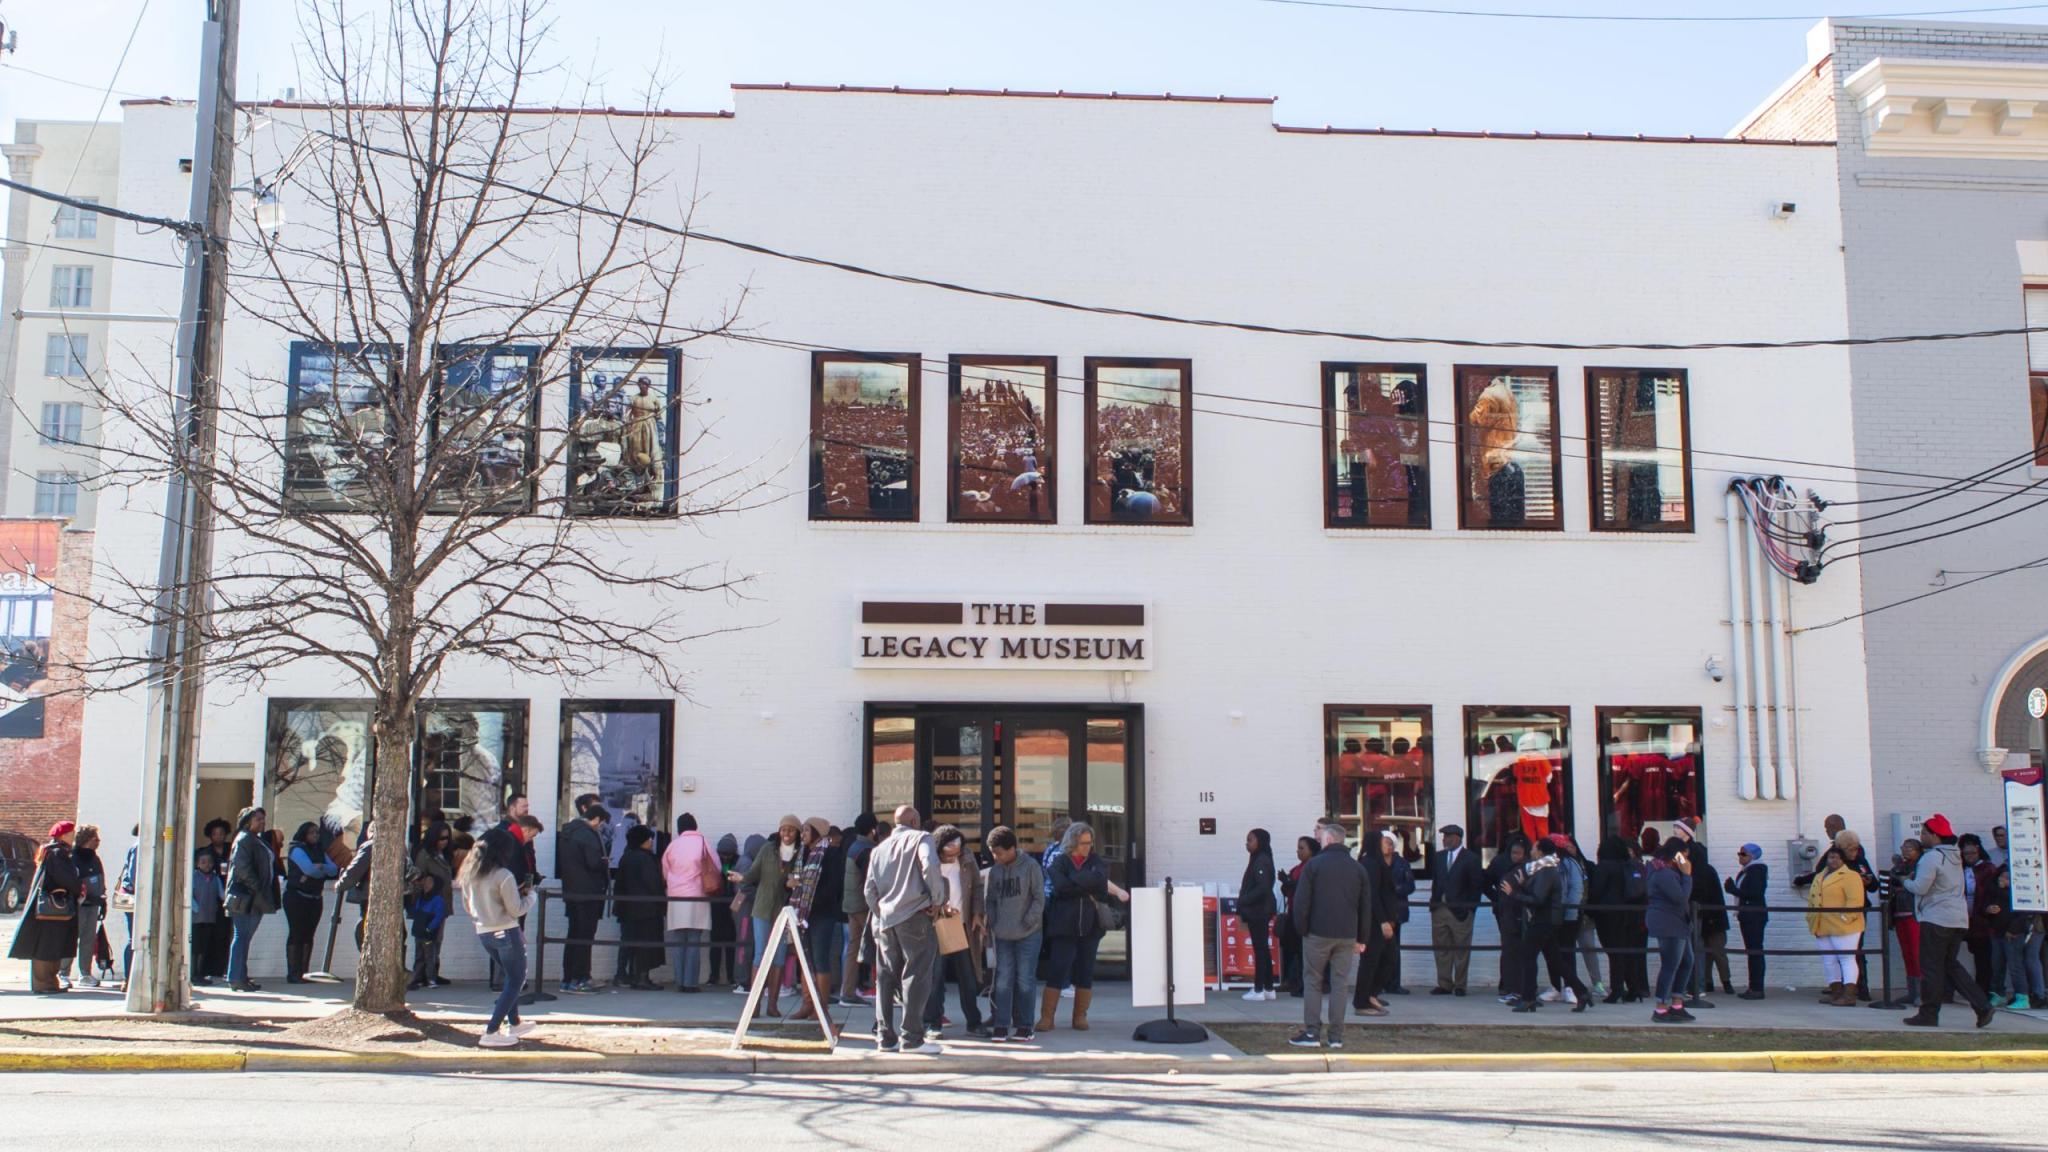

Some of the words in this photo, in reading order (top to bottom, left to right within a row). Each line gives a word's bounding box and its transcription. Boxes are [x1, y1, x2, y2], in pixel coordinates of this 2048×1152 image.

[0, 563, 38, 590] al
[971, 603, 1036, 625] THE
[861, 636, 989, 658] LEGACY
[1000, 637, 1145, 660] MUSEUM
[1199, 791, 1215, 803] 115
